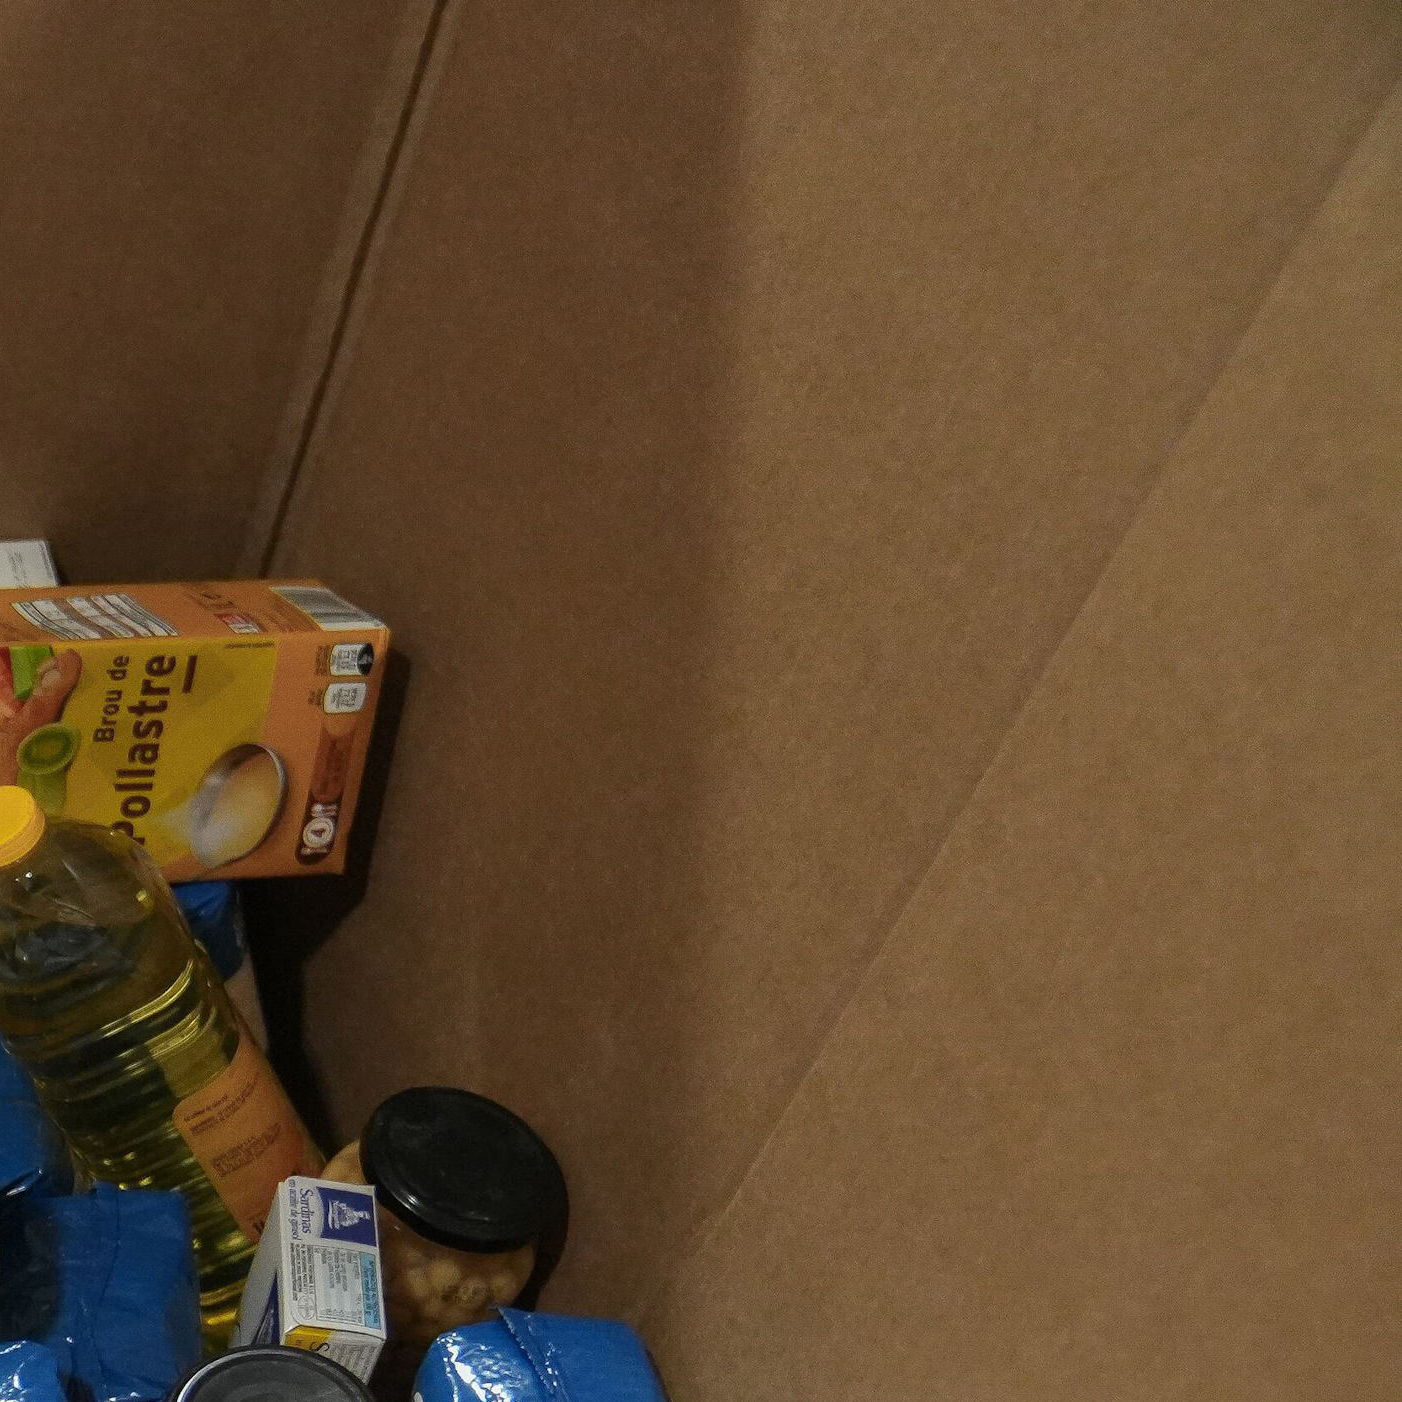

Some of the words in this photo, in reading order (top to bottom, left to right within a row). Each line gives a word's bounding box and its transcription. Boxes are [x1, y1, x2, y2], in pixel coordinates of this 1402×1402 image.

[107, 654, 131, 682] de
[92, 688, 125, 743] Brou
[110, 654, 178, 846] Pollastre
[297, 1187, 316, 1234] Sardinas
